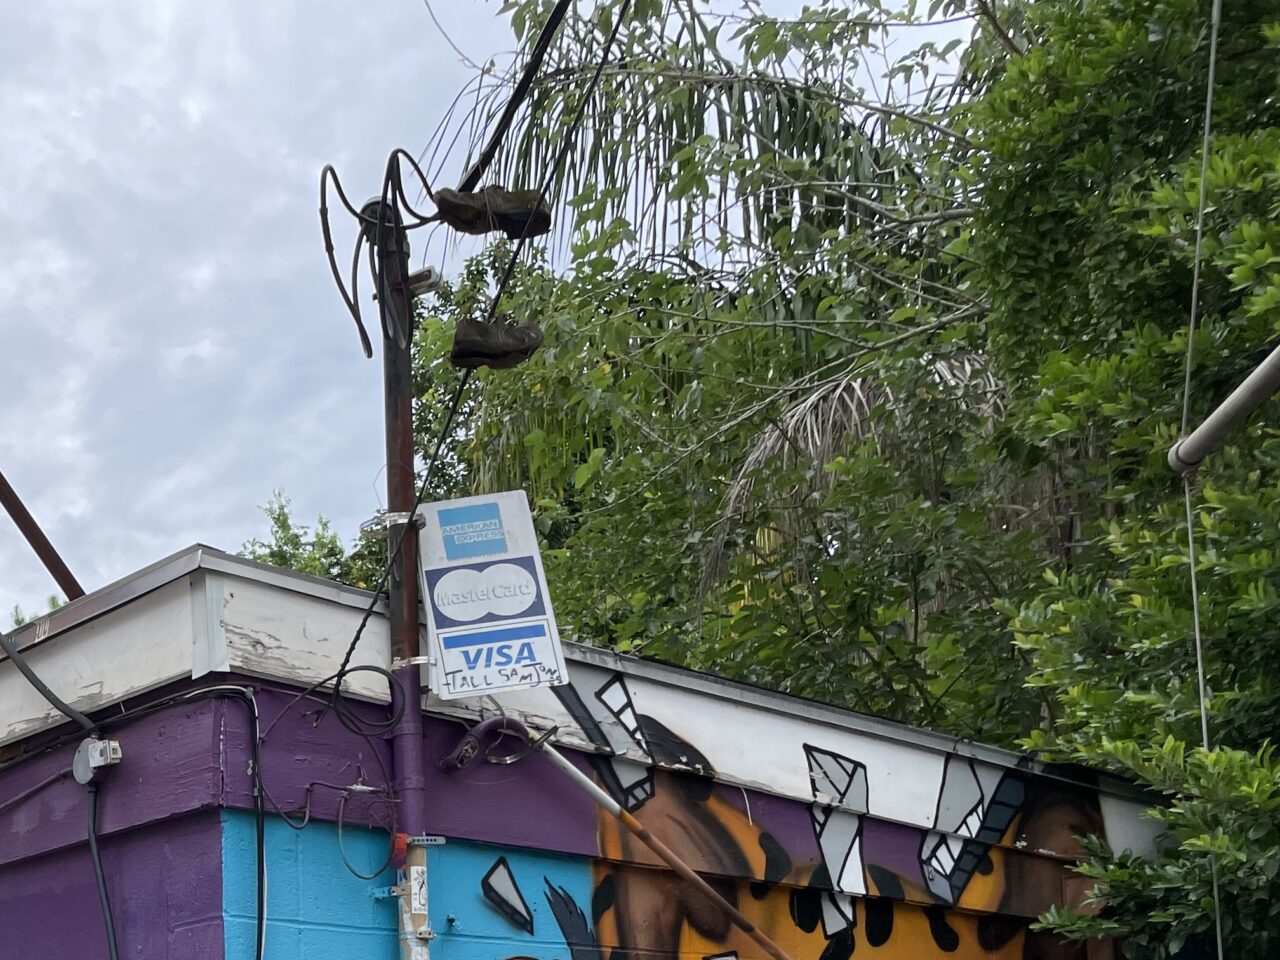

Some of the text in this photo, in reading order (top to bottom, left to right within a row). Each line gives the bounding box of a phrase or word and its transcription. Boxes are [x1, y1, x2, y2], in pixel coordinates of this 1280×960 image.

[442, 520, 498, 534] AMERICAN
[456, 530, 505, 543] EXPRESS
[437, 581, 532, 607] MasterCard
[461, 642, 537, 671] VISA
